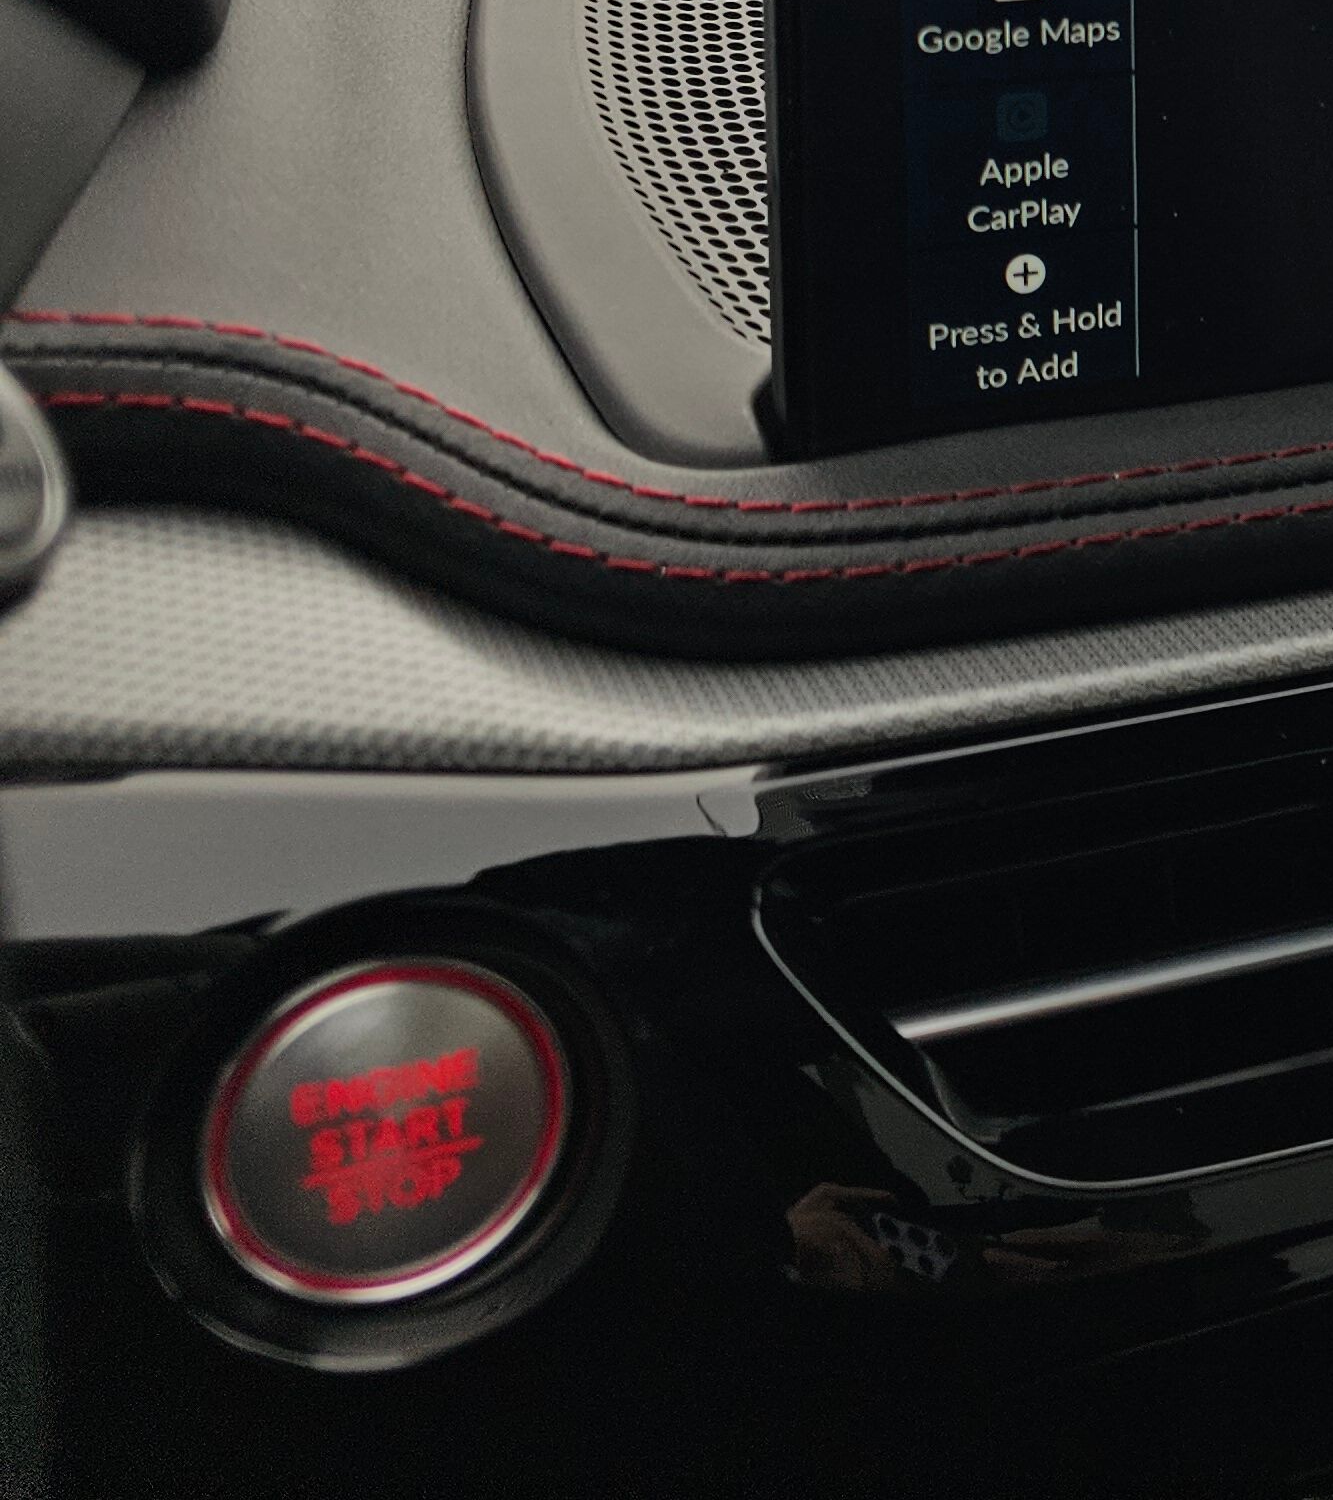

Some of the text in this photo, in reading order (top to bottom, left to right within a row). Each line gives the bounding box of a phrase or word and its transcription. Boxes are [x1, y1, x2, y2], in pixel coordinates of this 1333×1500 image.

[917, 17, 1121, 54] Google Maps
[979, 153, 1069, 188] Apple
[967, 199, 1082, 232] CarPlay
[929, 301, 1122, 351] Press & Hold
[977, 351, 1079, 390] to Add
